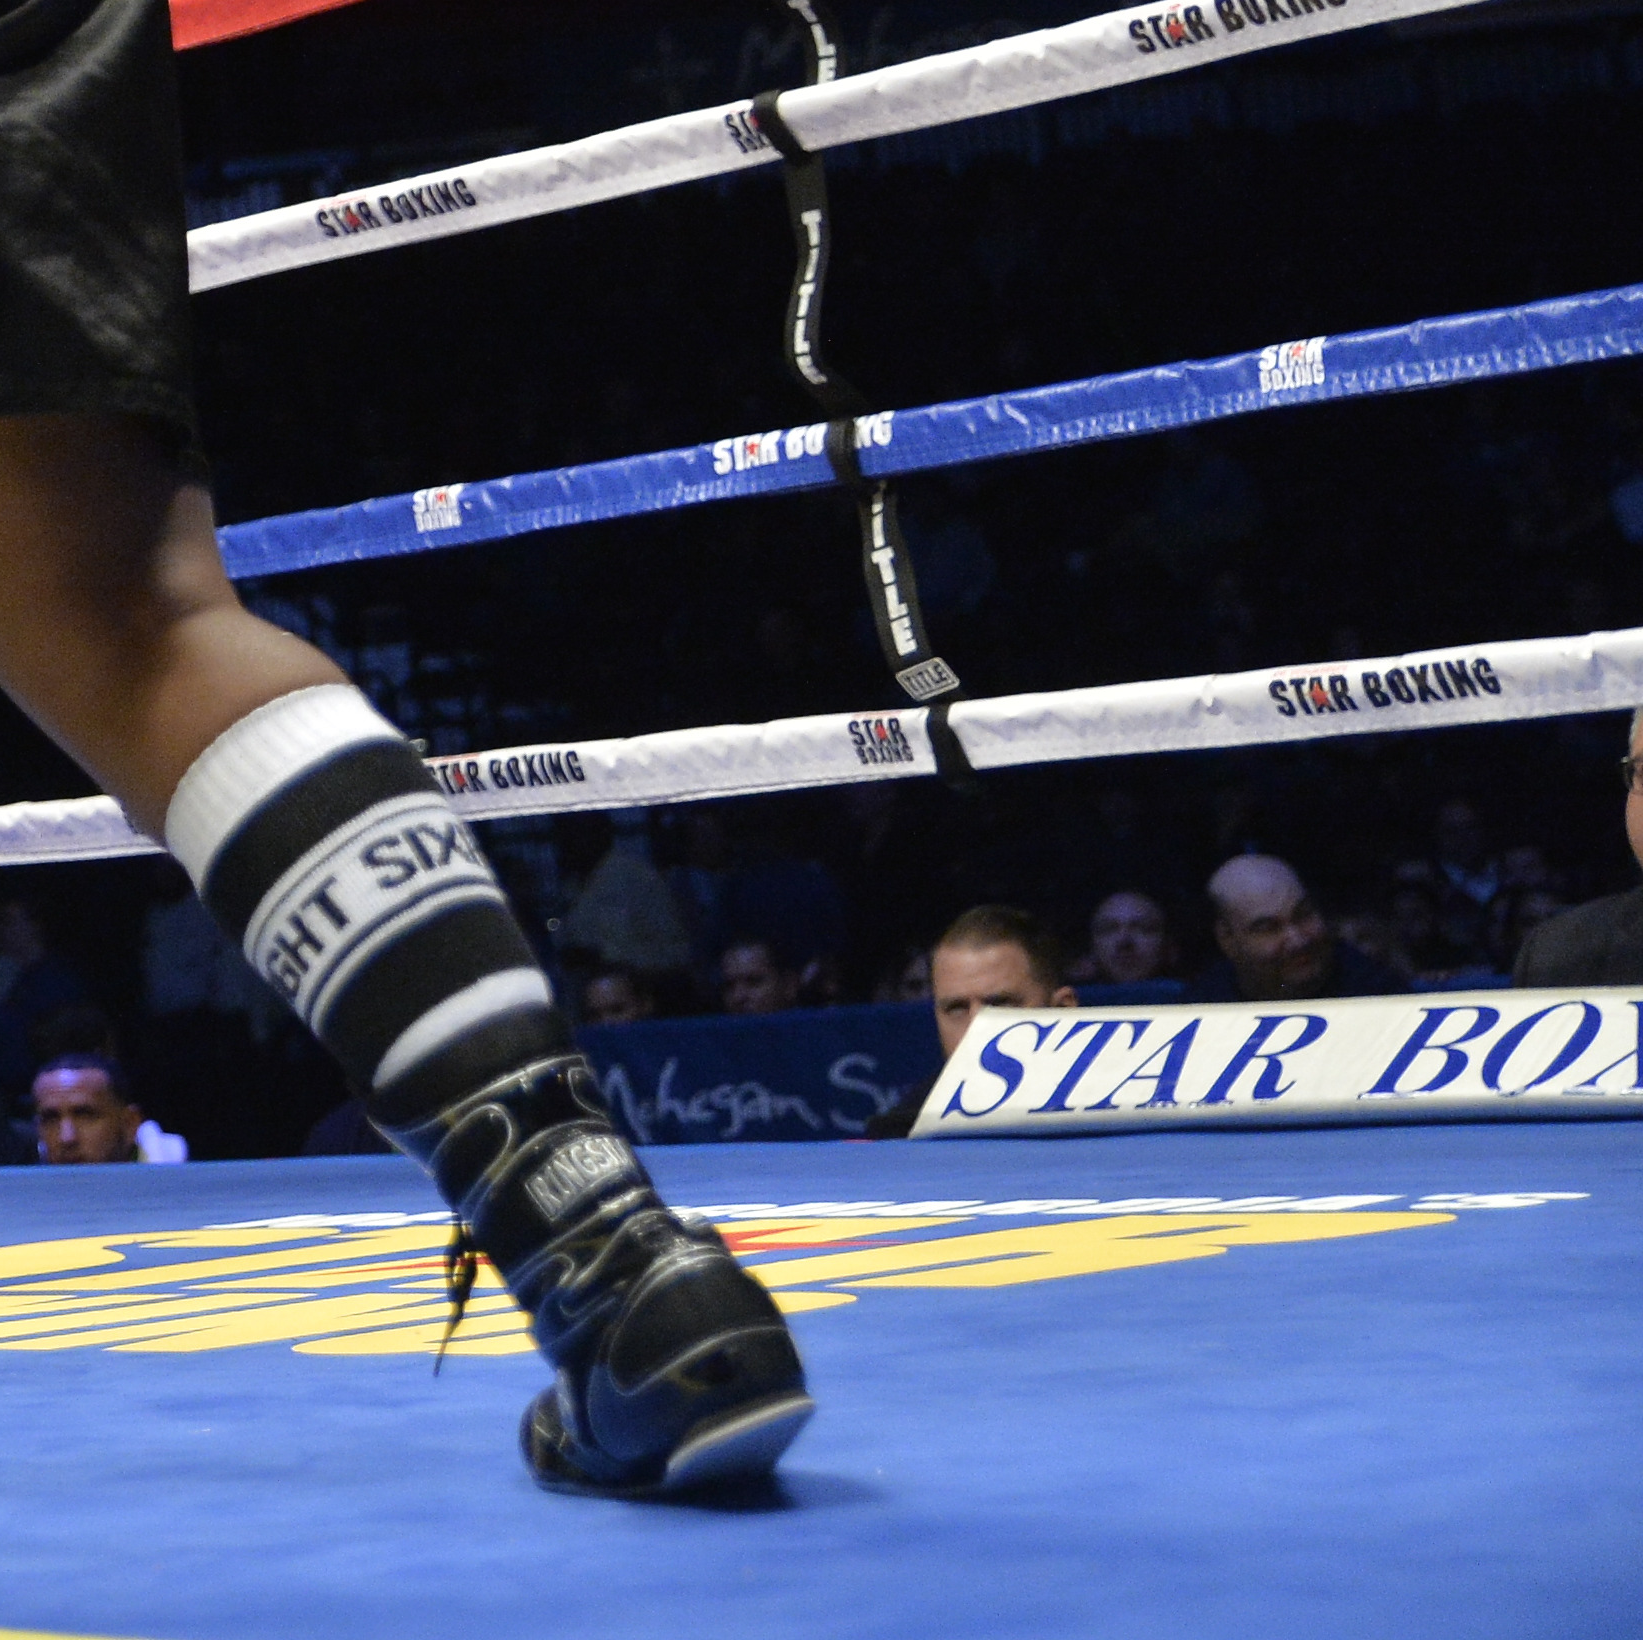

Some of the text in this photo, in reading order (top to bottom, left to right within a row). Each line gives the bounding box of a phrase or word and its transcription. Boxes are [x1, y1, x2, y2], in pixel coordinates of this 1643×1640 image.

[1128, 6, 1210, 54] STAR
[317, 178, 476, 239] STAR BOXING
[1258, 336, 1327, 371] STAR
[1258, 364, 1325, 394] BOXING
[714, 428, 778, 475] STAR
[904, 661, 947, 696] TITLE
[1268, 657, 1501, 717] STAR BOXING
[848, 718, 907, 747] STAR
[491, 750, 586, 792] BOXING
[941, 1013, 1328, 1119] STAR
